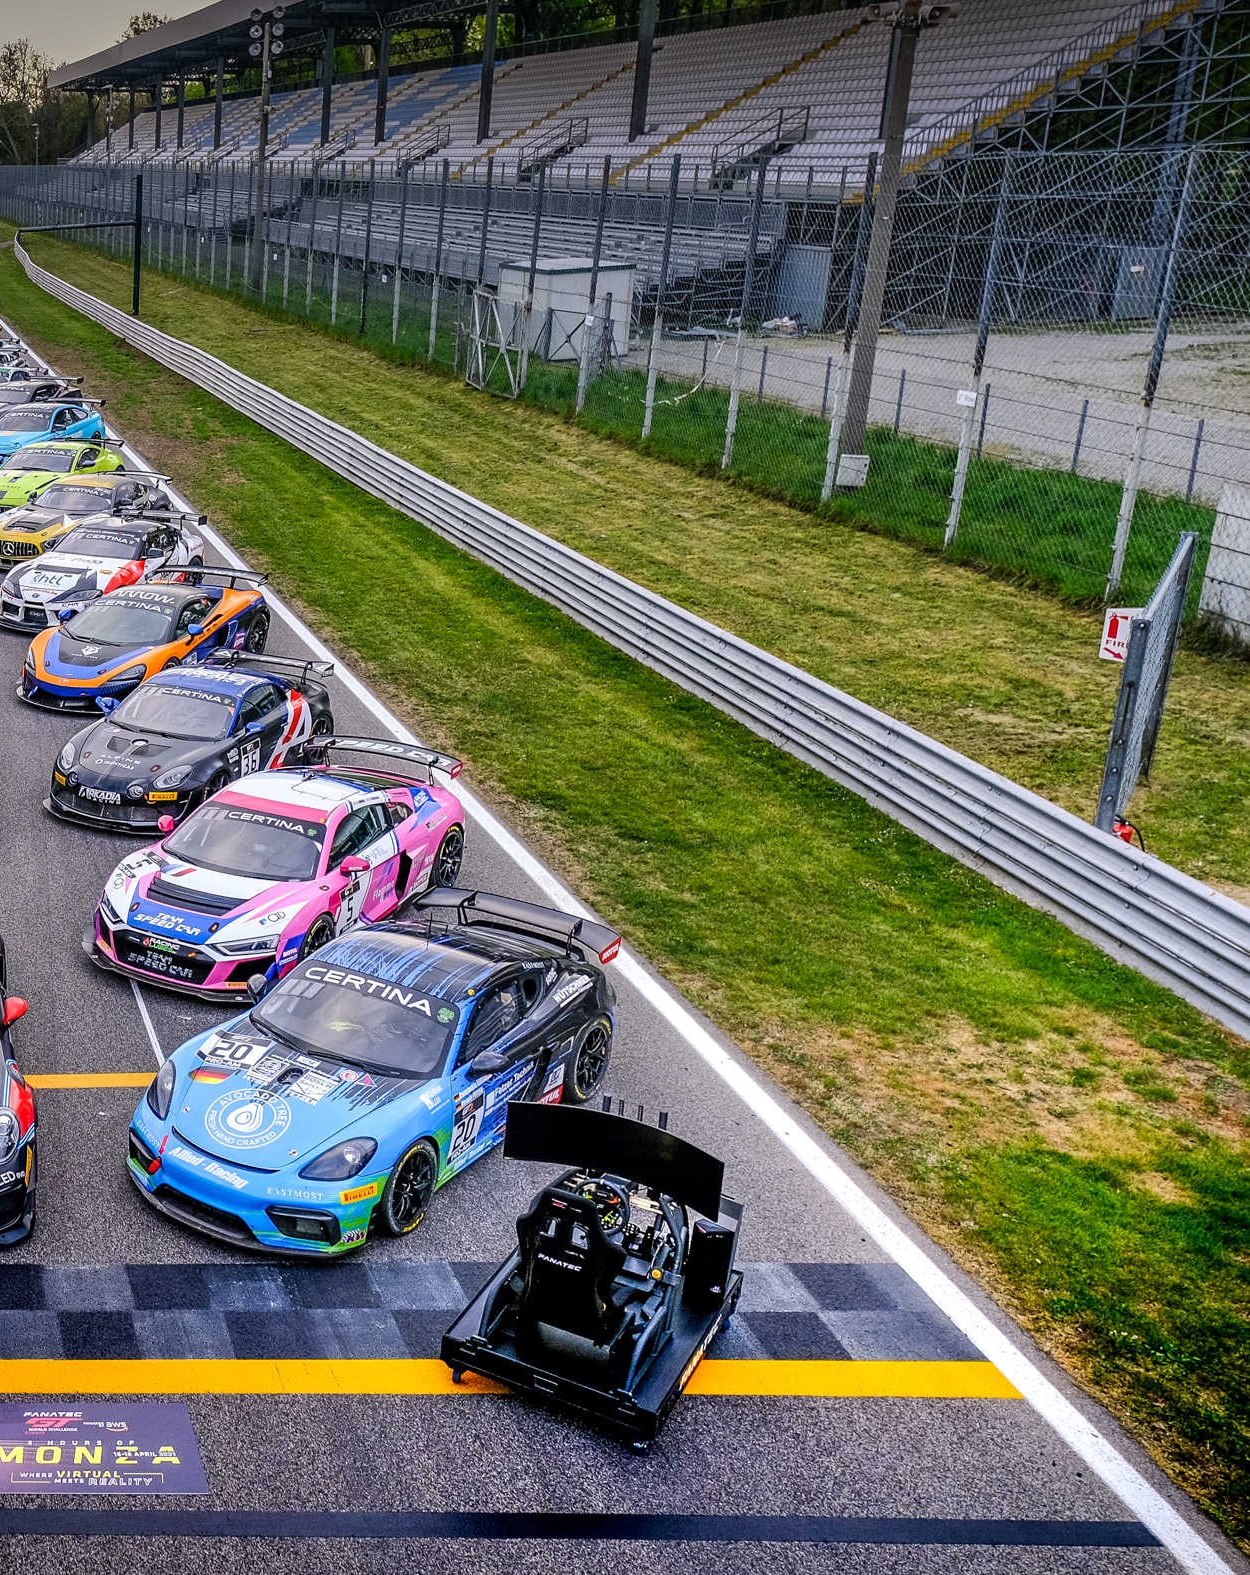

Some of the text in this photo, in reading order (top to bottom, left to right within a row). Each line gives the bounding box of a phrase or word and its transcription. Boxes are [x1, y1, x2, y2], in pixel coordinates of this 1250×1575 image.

[85, 533, 129, 545] CERTINA
[94, 599, 162, 612] CERTINA
[1105, 640, 1129, 650] FIR
[161, 687, 222, 703] CERTINA
[243, 751, 258, 776] 36
[78, 785, 121, 803] ARKADIA
[228, 810, 305, 834] CERTINA
[133, 913, 175, 929] SPEED
[149, 936, 181, 951] RACING
[303, 965, 433, 1018] CERTINA
[208, 1039, 254, 1062] 20
[204, 1056, 242, 1069] PRO-AM
[218, 1090, 288, 1127] AVOCADO TREE
[236, 1131, 277, 1147] CRAFTED
[453, 1114, 477, 1149] 20
[267, 1187, 326, 1201] EASTMOST
[343, 1185, 375, 1203] PIRELLI
[537, 1252, 582, 1272] FANATEC
[25, 1417, 77, 1428] GT
[56, 1470, 121, 1478] VIRTUAL
[88, 1477, 154, 1486] REALITY
